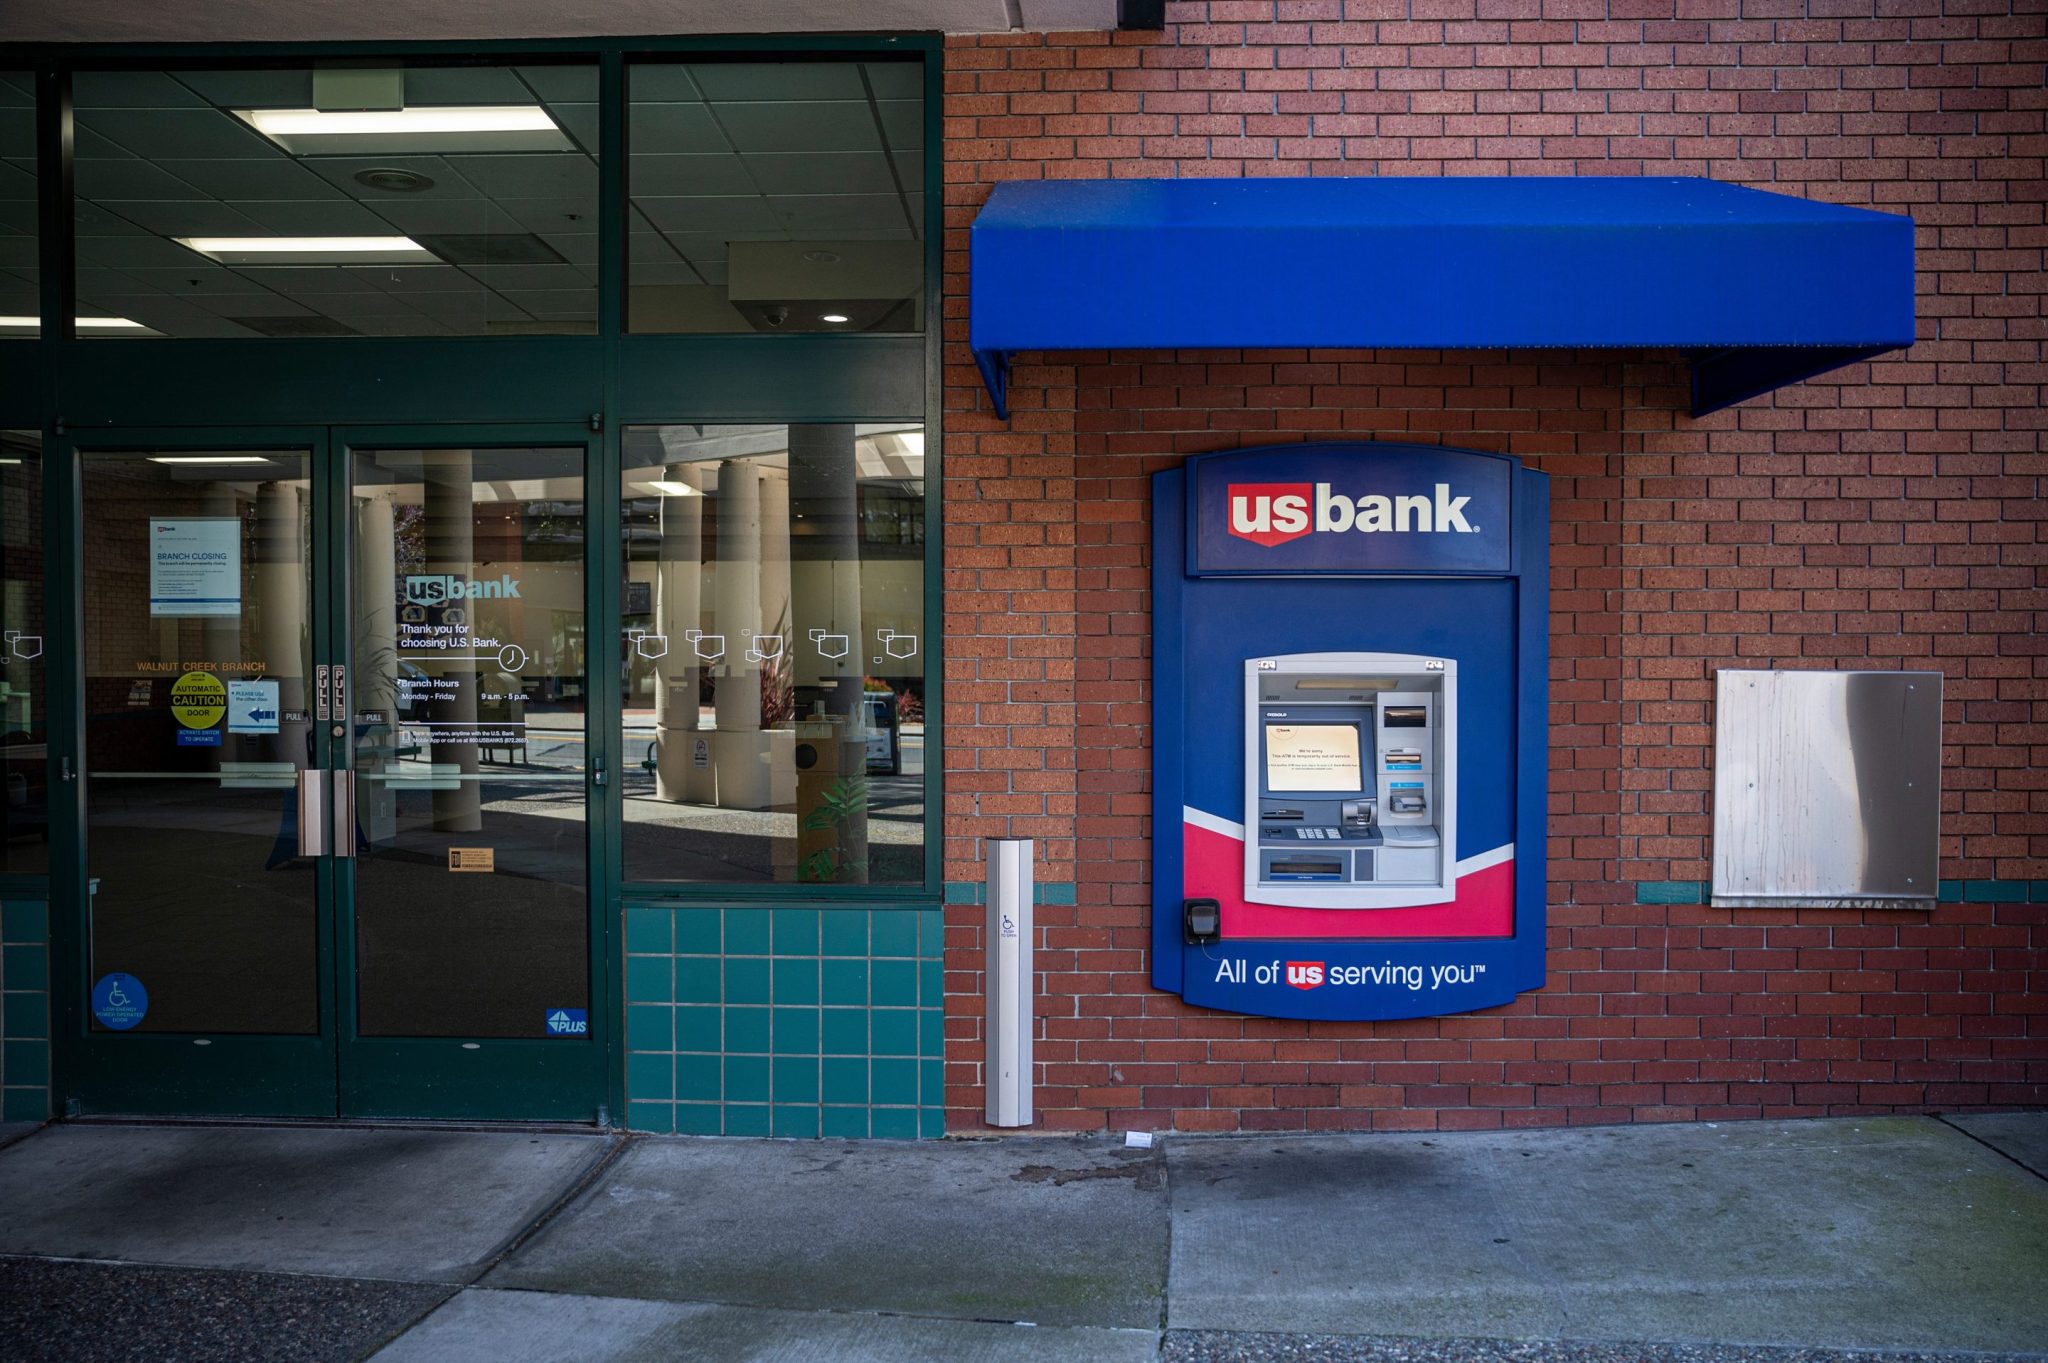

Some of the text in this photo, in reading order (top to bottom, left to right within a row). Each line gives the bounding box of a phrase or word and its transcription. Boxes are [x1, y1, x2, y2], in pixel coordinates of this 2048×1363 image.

[157, 552, 227, 560] BRANCH CLOSING
[400, 623, 470, 636] Thank you for
[400, 637, 501, 650] choosing U.S. Bank.
[136, 662, 266, 672] WALNUT CREEK BRANCH
[319, 670, 328, 707] PULL
[335, 670, 344, 707] PULL
[401, 679, 460, 688] Branch Hours
[176, 685, 221, 693] AUTOMATIC
[172, 695, 225, 705] CAUTION
[401, 693, 429, 701] Monday
[434, 693, 456, 701] Friday
[514, 694, 530, 702] p.m.
[187, 709, 210, 717] DOOR
[1215, 959, 1247, 984] All
[1254, 960, 1280, 984] of
[1287, 965, 1324, 985] us
[1329, 960, 1423, 990] serving
[558, 1021, 587, 1033] PLUS
